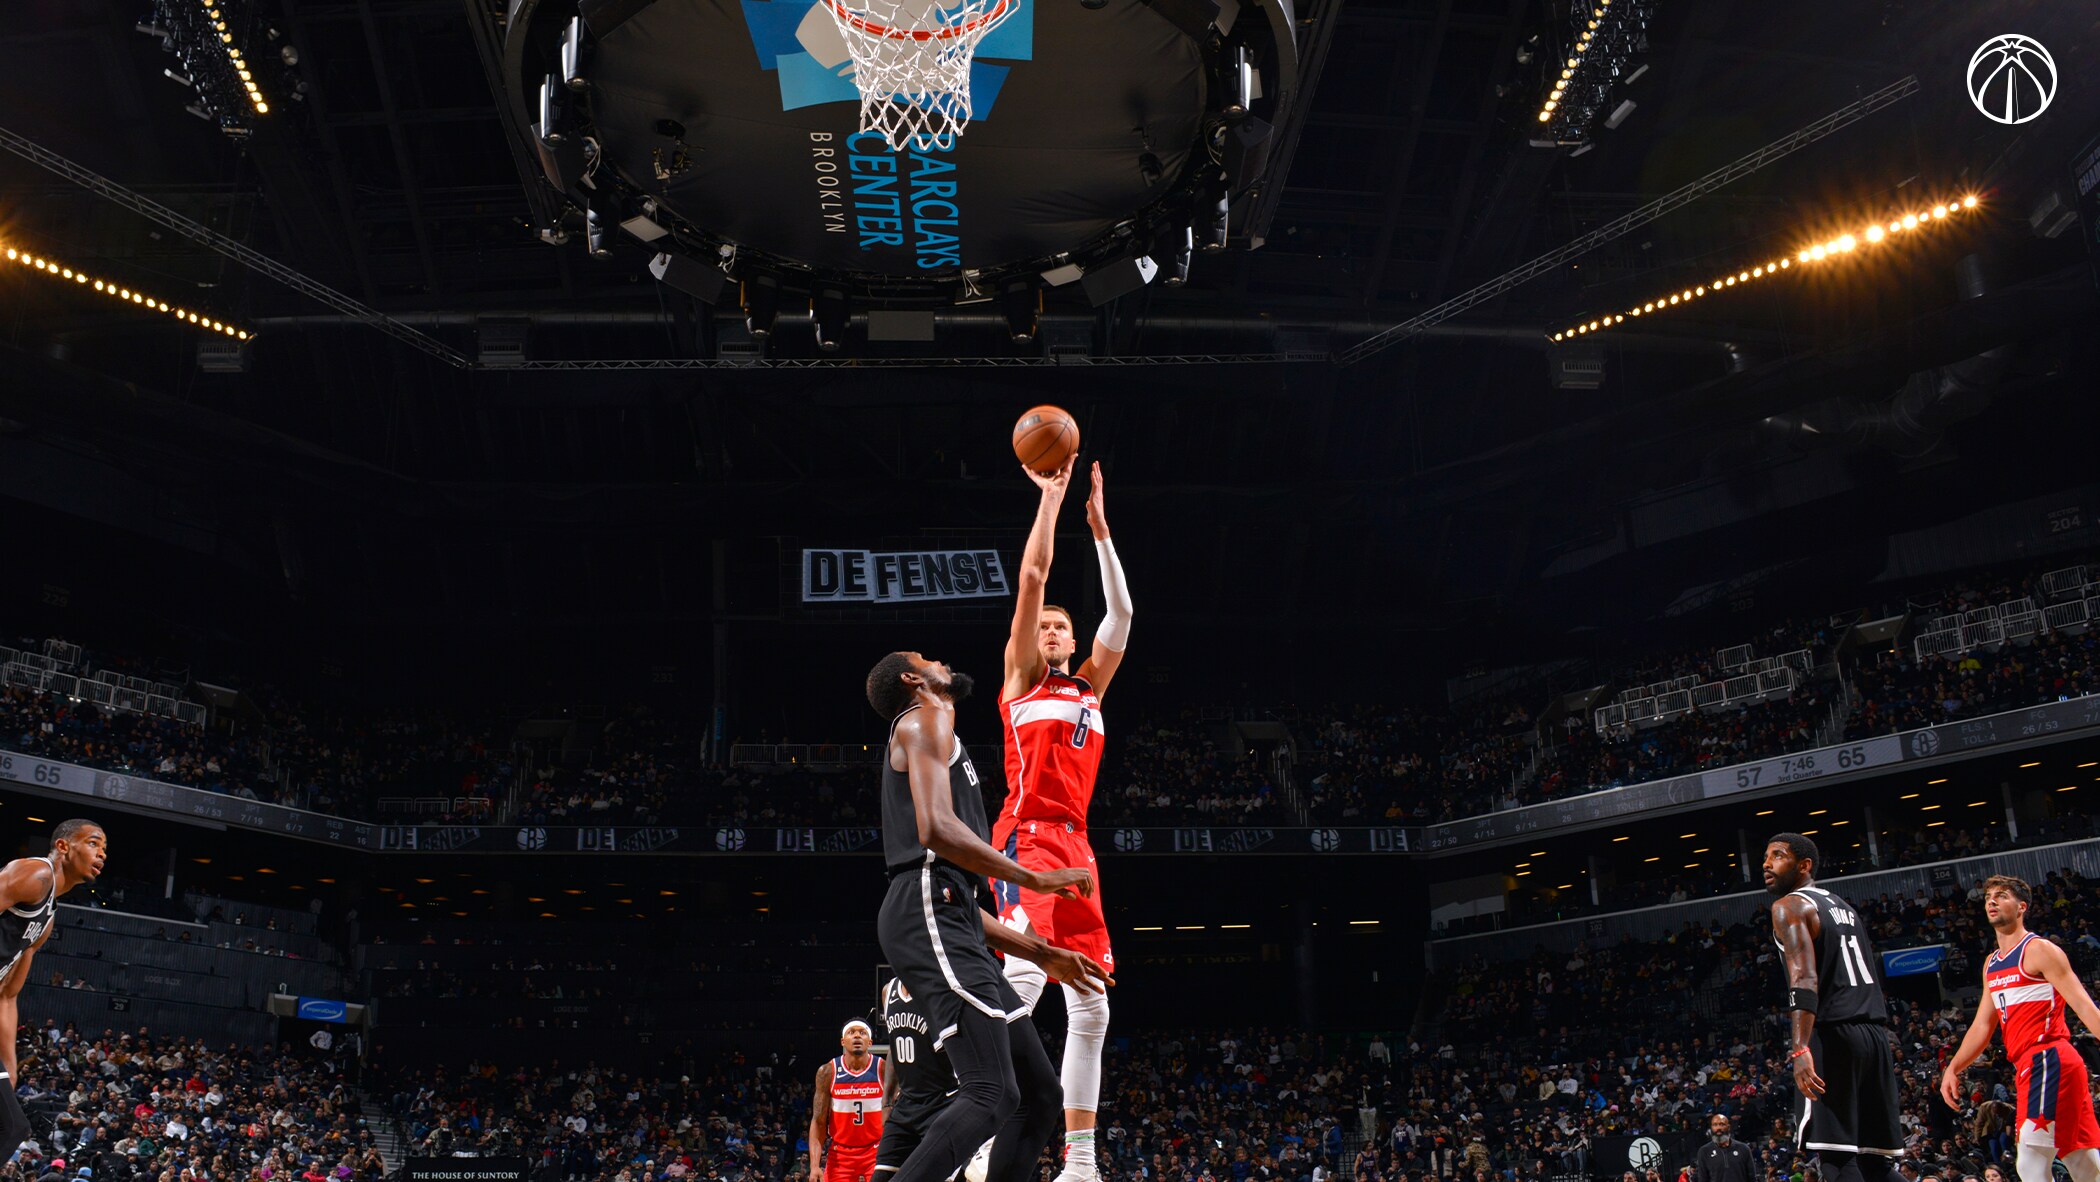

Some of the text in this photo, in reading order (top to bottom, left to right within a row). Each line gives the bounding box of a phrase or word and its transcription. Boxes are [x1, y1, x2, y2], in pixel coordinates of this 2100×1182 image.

[810, 132, 846, 234] BROOKLYN
[846, 131, 904, 248] CENTER
[907, 132, 961, 269] BARCLAYS
[2050, 514, 2081, 532] 204
[809, 551, 1005, 598] DEFENSE
[2031, 710, 2046, 719] FG
[2084, 713, 2091, 723] 7
[1071, 706, 1091, 748] 6
[2022, 725, 2035, 735] 26
[2045, 720, 2058, 730] 53
[1989, 733, 1996, 742] 4
[1782, 756, 1815, 774] 7:46
[1838, 746, 1866, 769] 65
[34, 763, 61, 785] 65
[1737, 766, 1763, 788] 57
[1777, 768, 1823, 784] 3rd Quarter
[194, 805, 204, 814] 26
[212, 808, 222, 817] 53
[240, 814, 246, 822] 7
[355, 826, 371, 836] AST
[1528, 820, 1537, 829] 14
[329, 831, 340, 840] 22
[1486, 829, 1495, 838] 14
[1432, 840, 1441, 848] 22
[1935, 871, 1951, 879] 104
[1840, 935, 1874, 986] 11
[1998, 992, 2007, 1023] 9
[886, 1012, 929, 1036] BROOKLYN
[895, 1036, 915, 1064] 00
[834, 1085, 880, 1096] washington
[853, 1101, 864, 1126] 3
[412, 1171, 520, 1180] THE HOUSE OF SUNTORY
